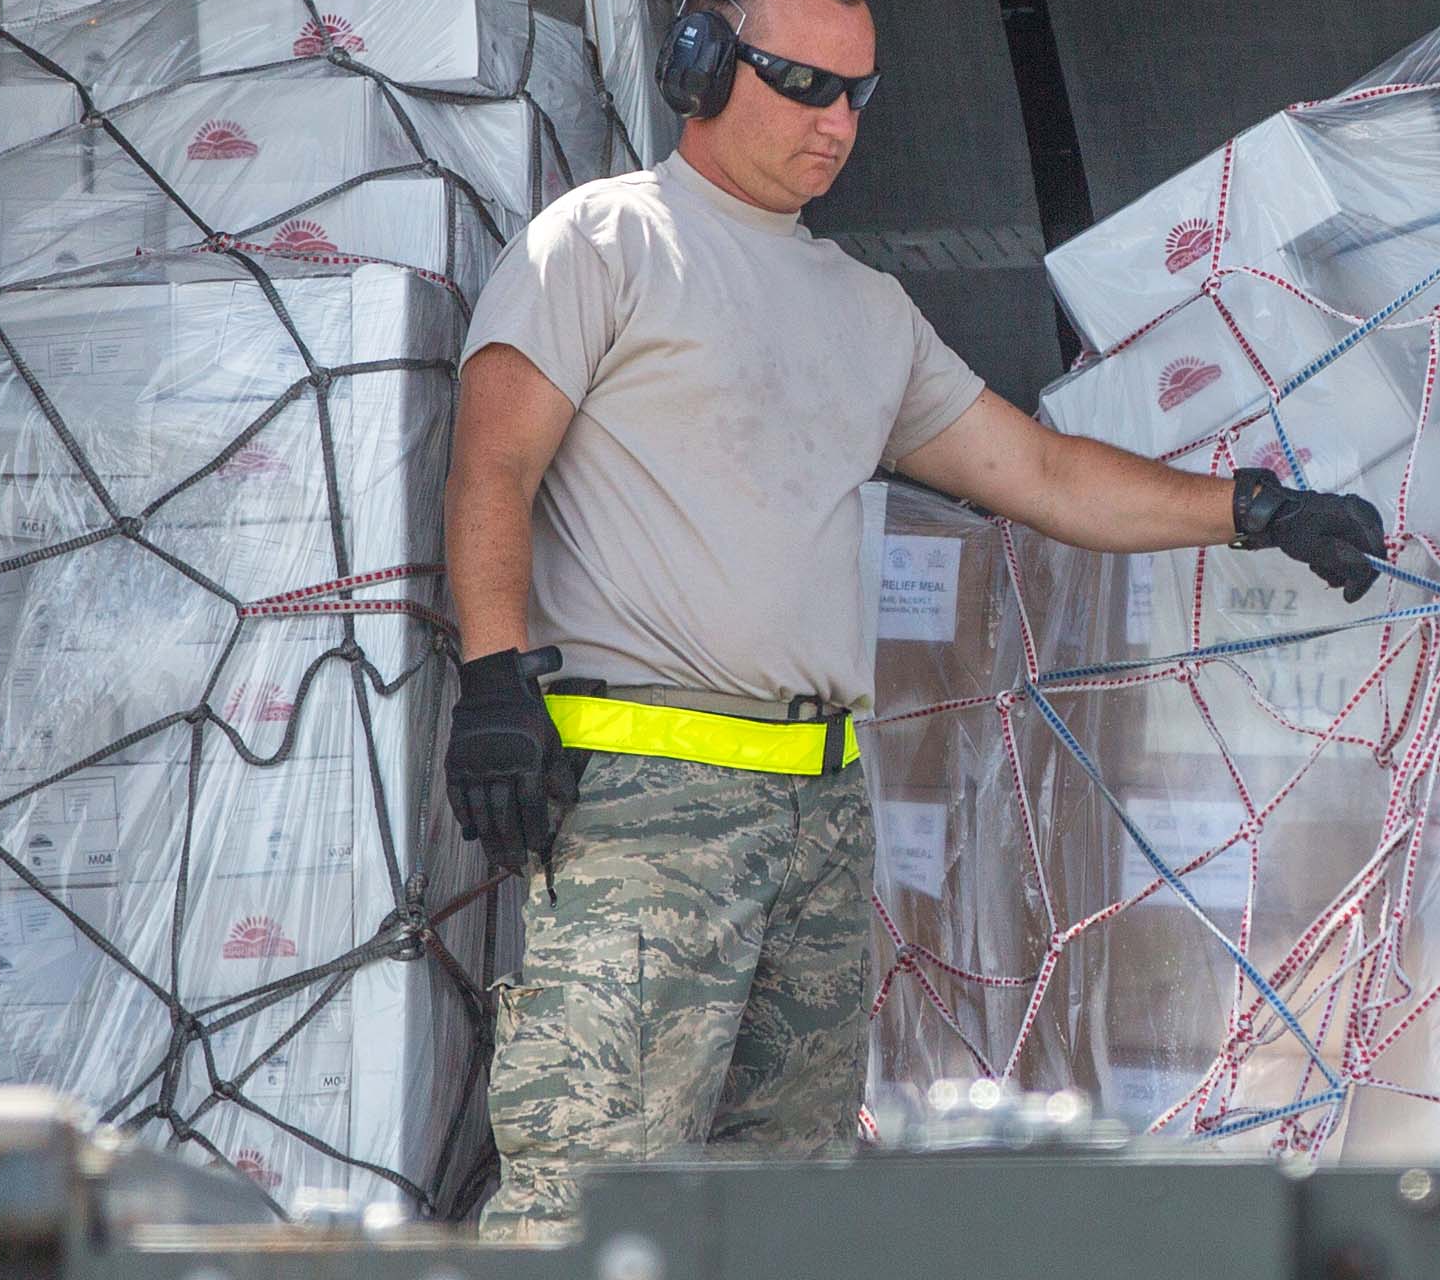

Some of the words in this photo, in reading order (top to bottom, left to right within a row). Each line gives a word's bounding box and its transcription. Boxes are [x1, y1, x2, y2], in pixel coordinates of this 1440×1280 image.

[881, 579, 918, 591] RELIEF
[919, 581, 946, 592] MEAL
[1231, 588, 1274, 610] MV
[1285, 590, 1298, 610] 2
[86, 852, 112, 864] M04
